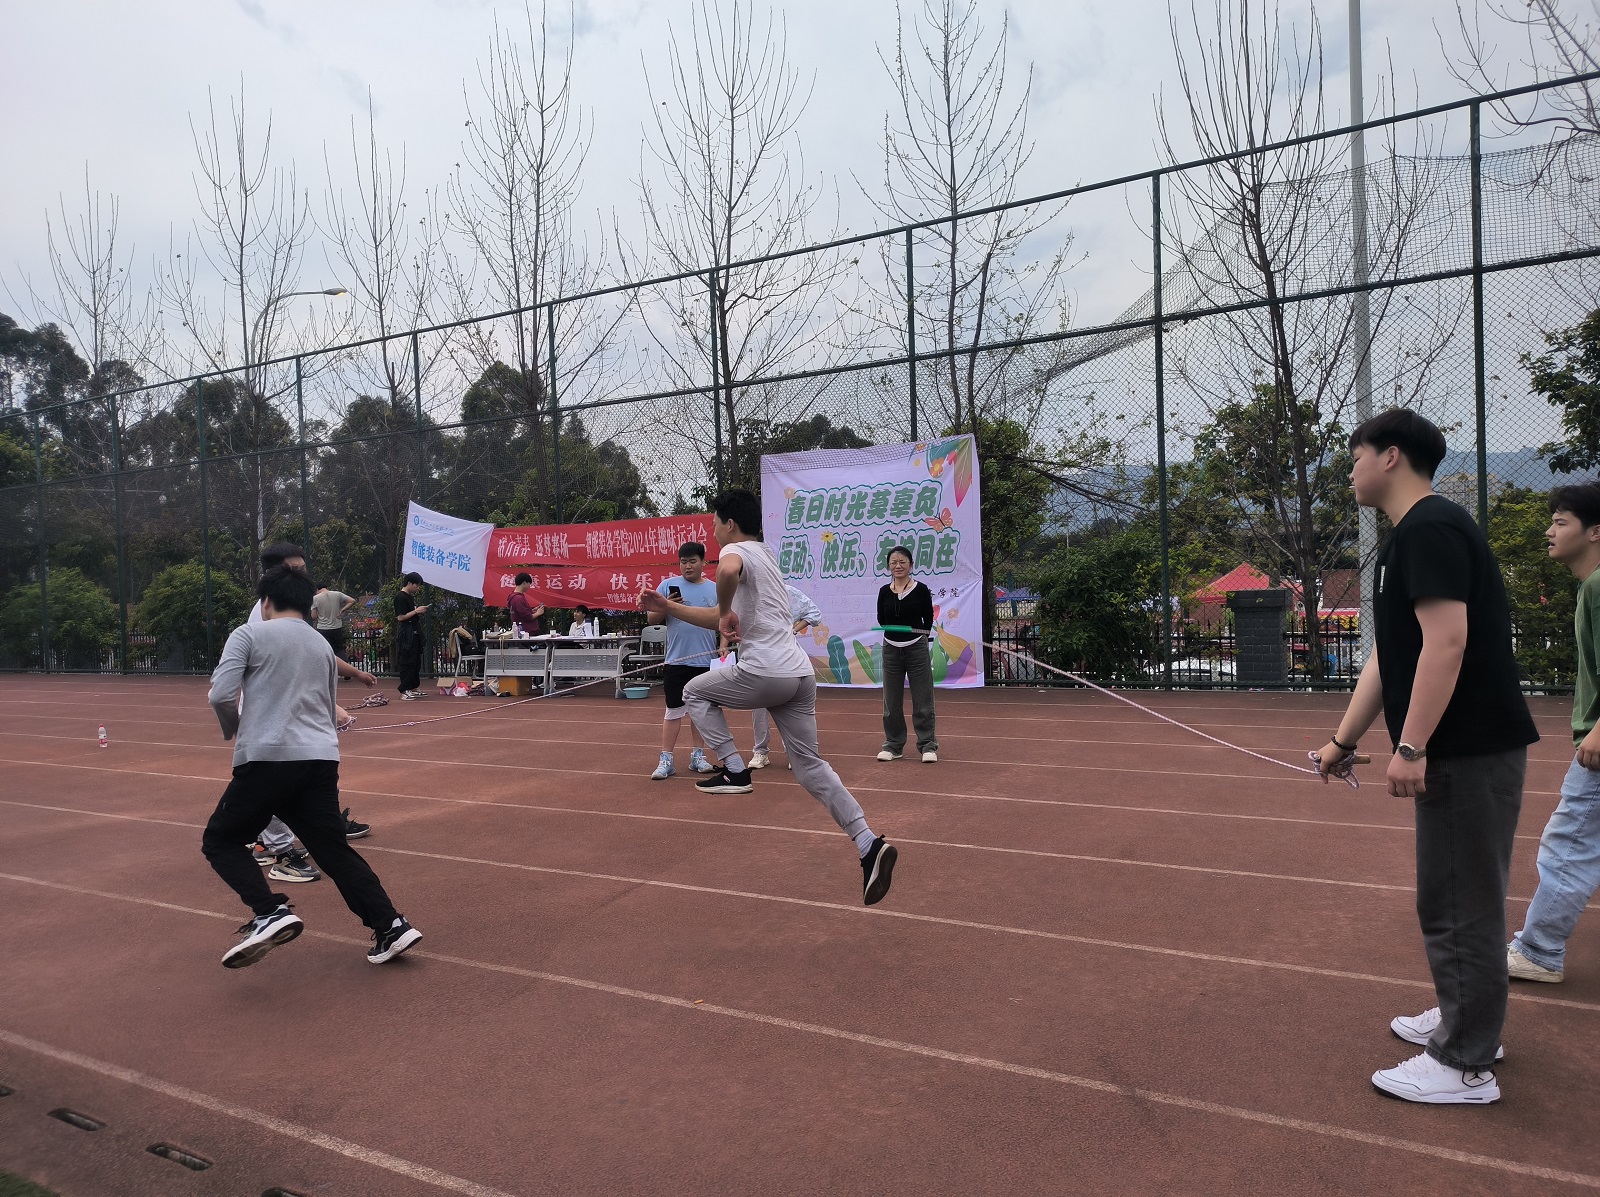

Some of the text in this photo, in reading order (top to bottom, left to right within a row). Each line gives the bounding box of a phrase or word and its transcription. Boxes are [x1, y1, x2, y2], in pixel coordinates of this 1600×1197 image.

[787, 485, 939, 525] 春日时光莫辜负
[411, 538, 472, 572] 智能装备学院
